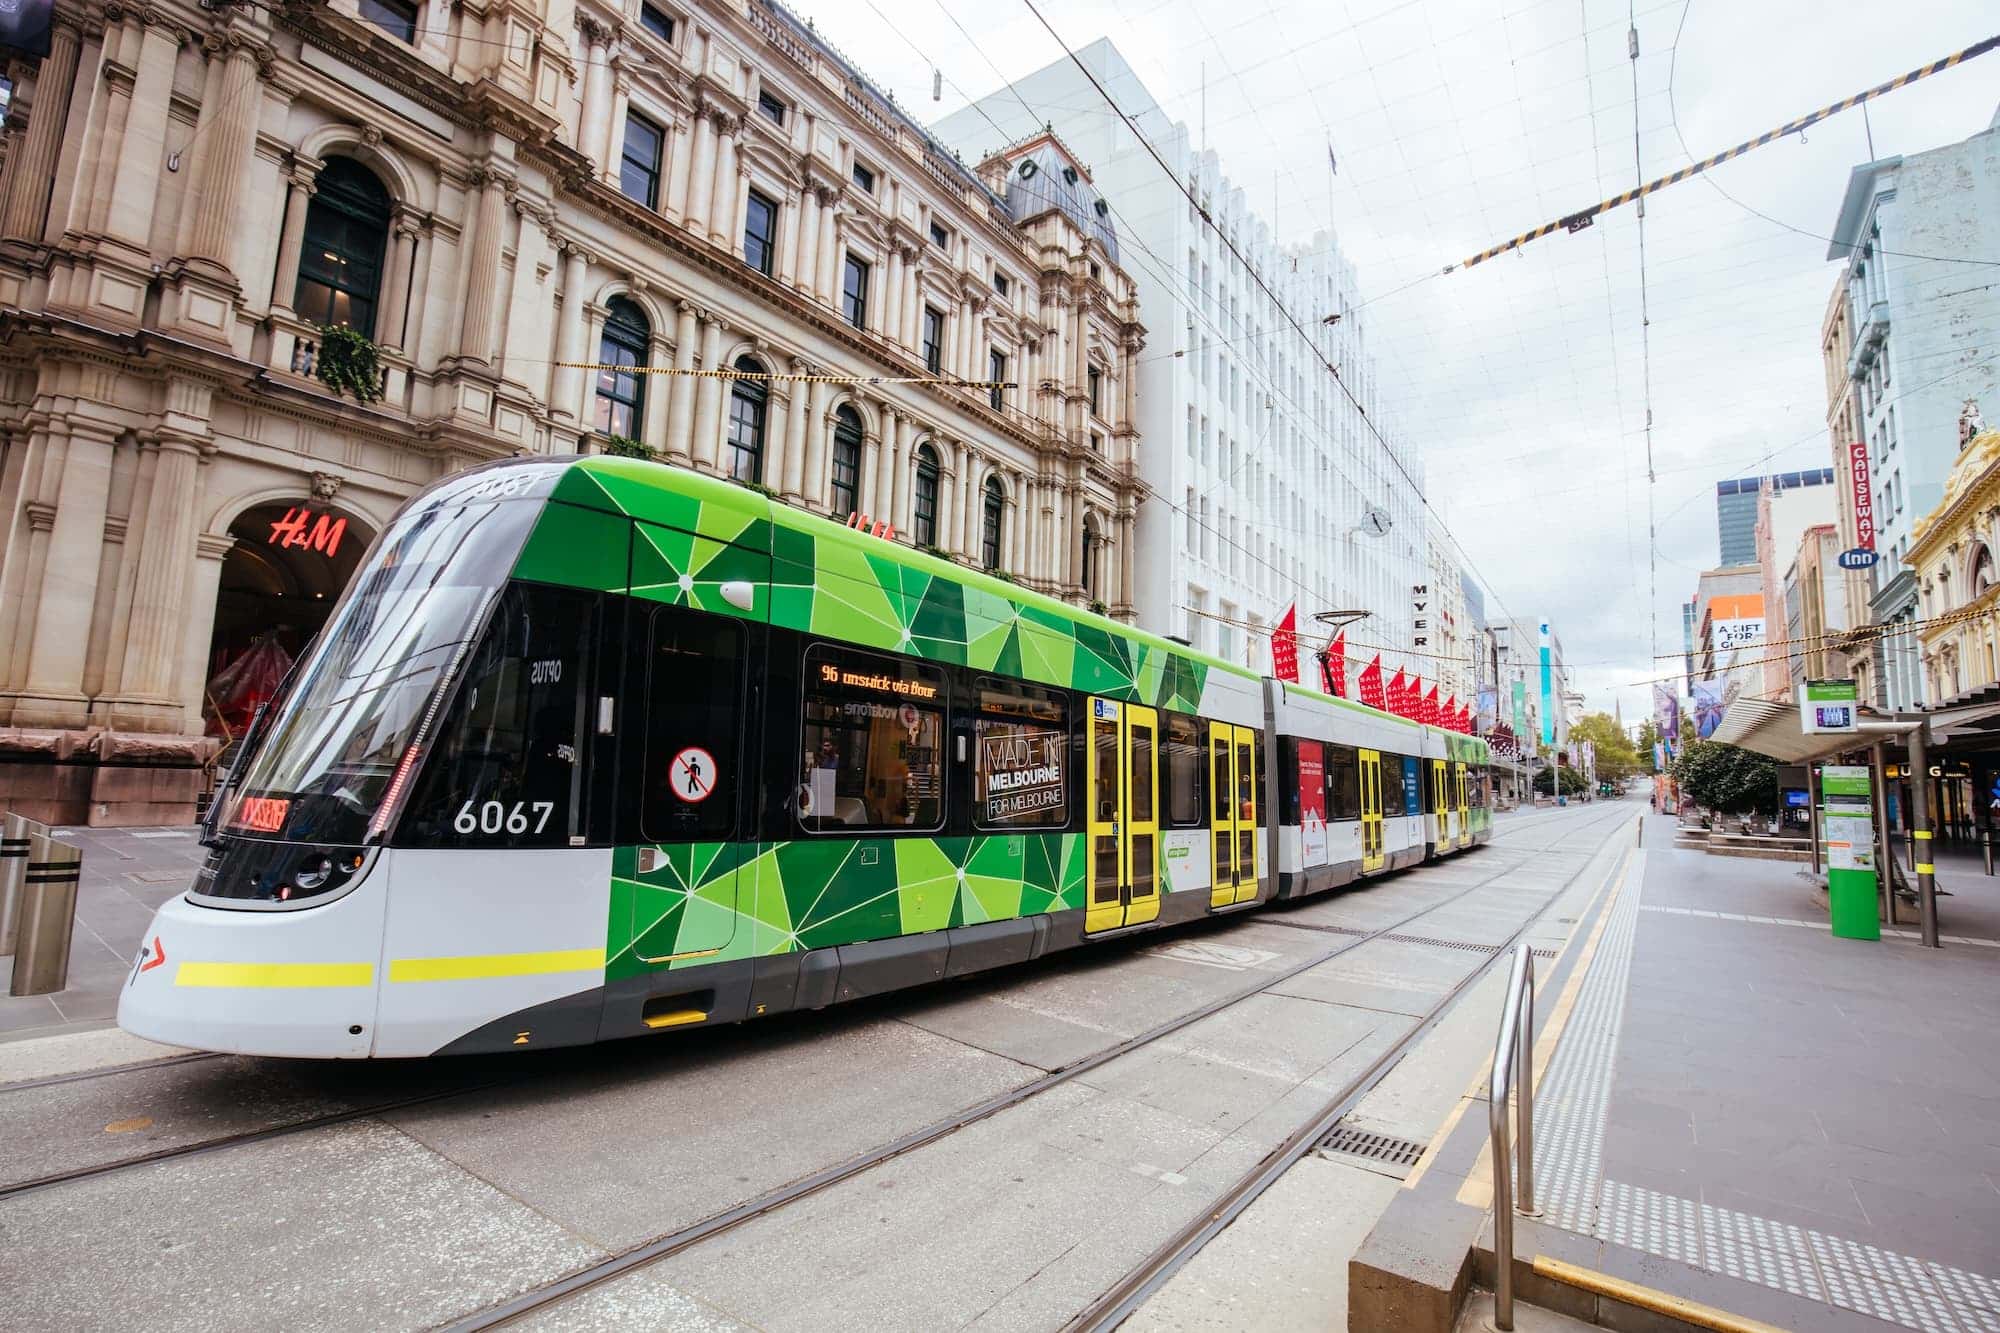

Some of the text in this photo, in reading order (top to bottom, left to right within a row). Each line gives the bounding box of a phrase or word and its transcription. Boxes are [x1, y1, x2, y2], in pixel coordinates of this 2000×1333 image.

[1853, 446, 1873, 543] CAUSEWAY
[268, 506, 347, 557] H&M
[1844, 552, 1873, 566] Inn
[1413, 585, 1427, 646] MYER
[822, 665, 838, 682] 96
[892, 680, 909, 694] via
[986, 735, 1059, 772] MADE IN
[988, 766, 1060, 791] MELBOURNE
[1900, 766, 1941, 777] UG
[454, 800, 554, 834] 6067
[990, 788, 1061, 815] FOR MELBOURNE
